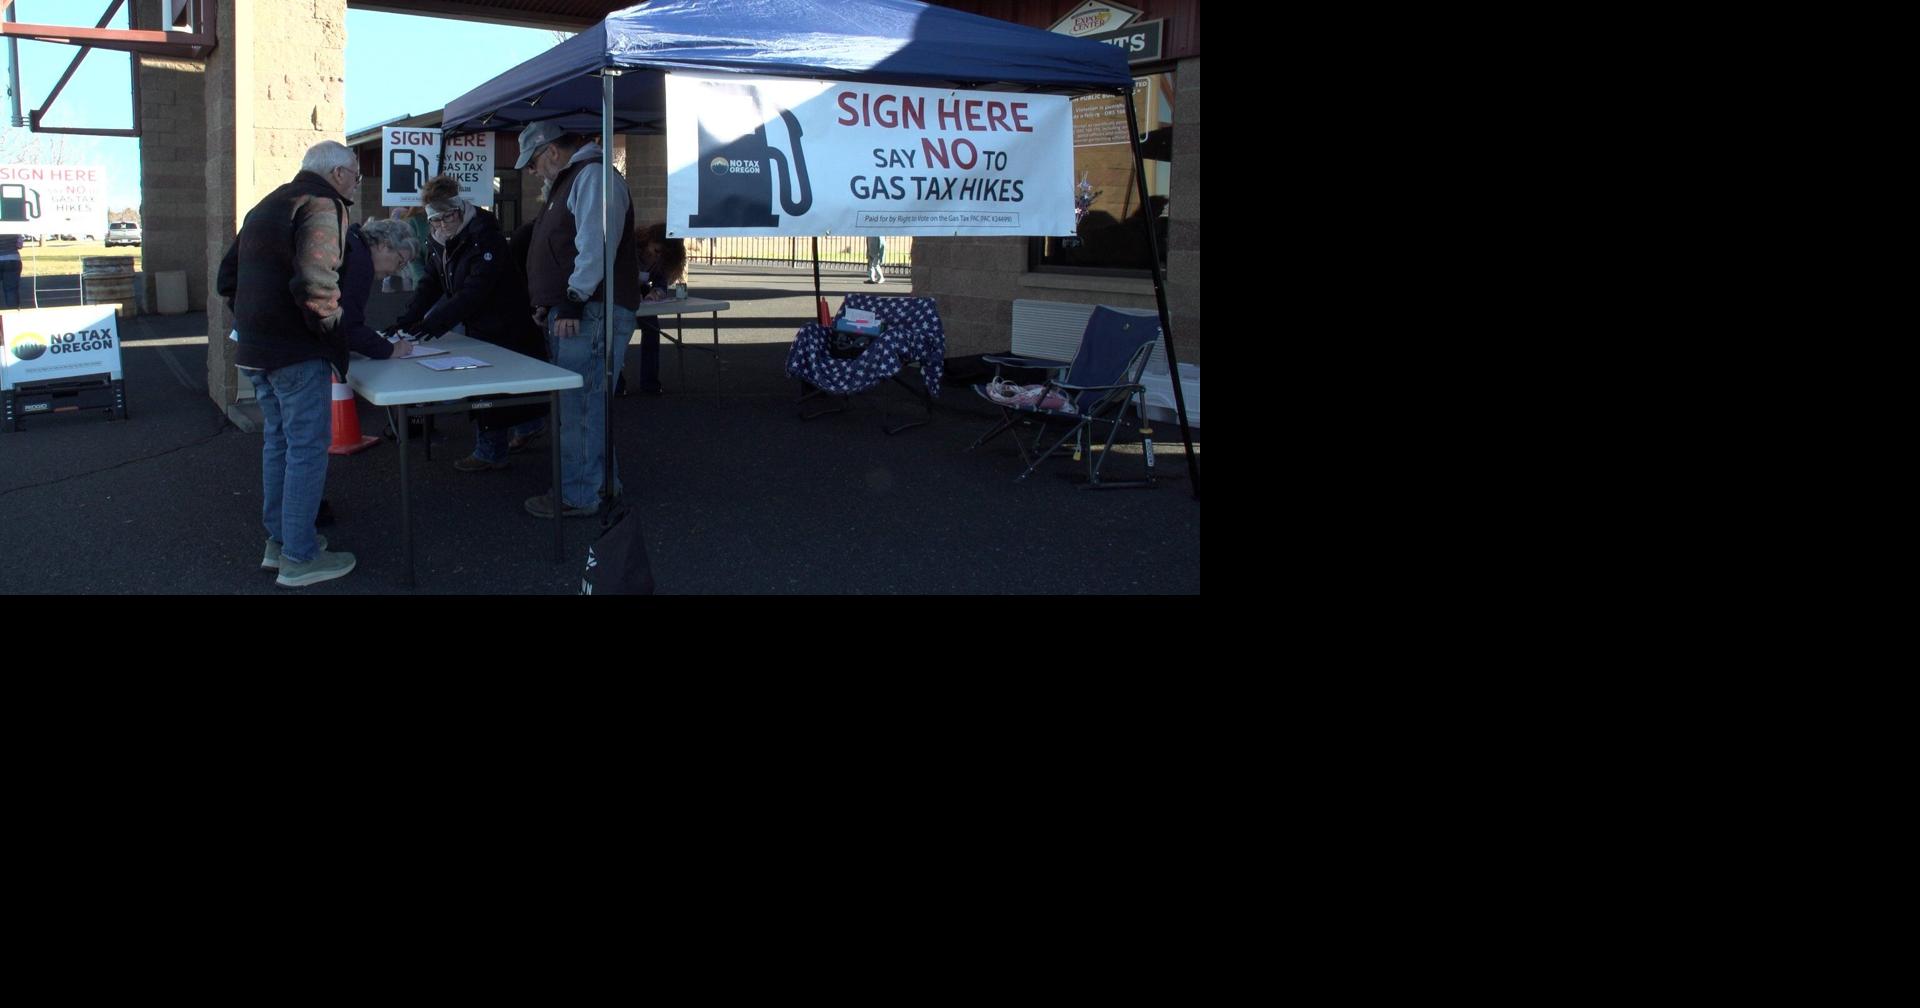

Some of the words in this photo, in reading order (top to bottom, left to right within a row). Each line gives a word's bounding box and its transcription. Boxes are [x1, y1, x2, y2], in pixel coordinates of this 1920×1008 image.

[837, 91, 926, 130] SIGN
[938, 98, 1034, 133] HERE
[390, 131, 434, 146] SIGN
[454, 151, 474, 162] NO
[476, 154, 487, 162] TO
[873, 148, 916, 169] SAY
[921, 137, 978, 170] NO
[982, 150, 1008, 171] TO
[463, 163, 483, 171] TAX
[729, 159, 743, 167] NO
[743, 160, 760, 168] TAX
[0, 167, 43, 180] SIGN
[50, 169, 97, 182] HERE
[850, 175, 906, 200] GAS
[910, 176, 958, 201] TAX
[959, 177, 1024, 202] HIKES
[889, 215, 897, 224] by
[939, 214, 948, 222] the
[50, 332, 76, 345] NO
[78, 328, 112, 341] TAX
[50, 339, 113, 355] OREGON
